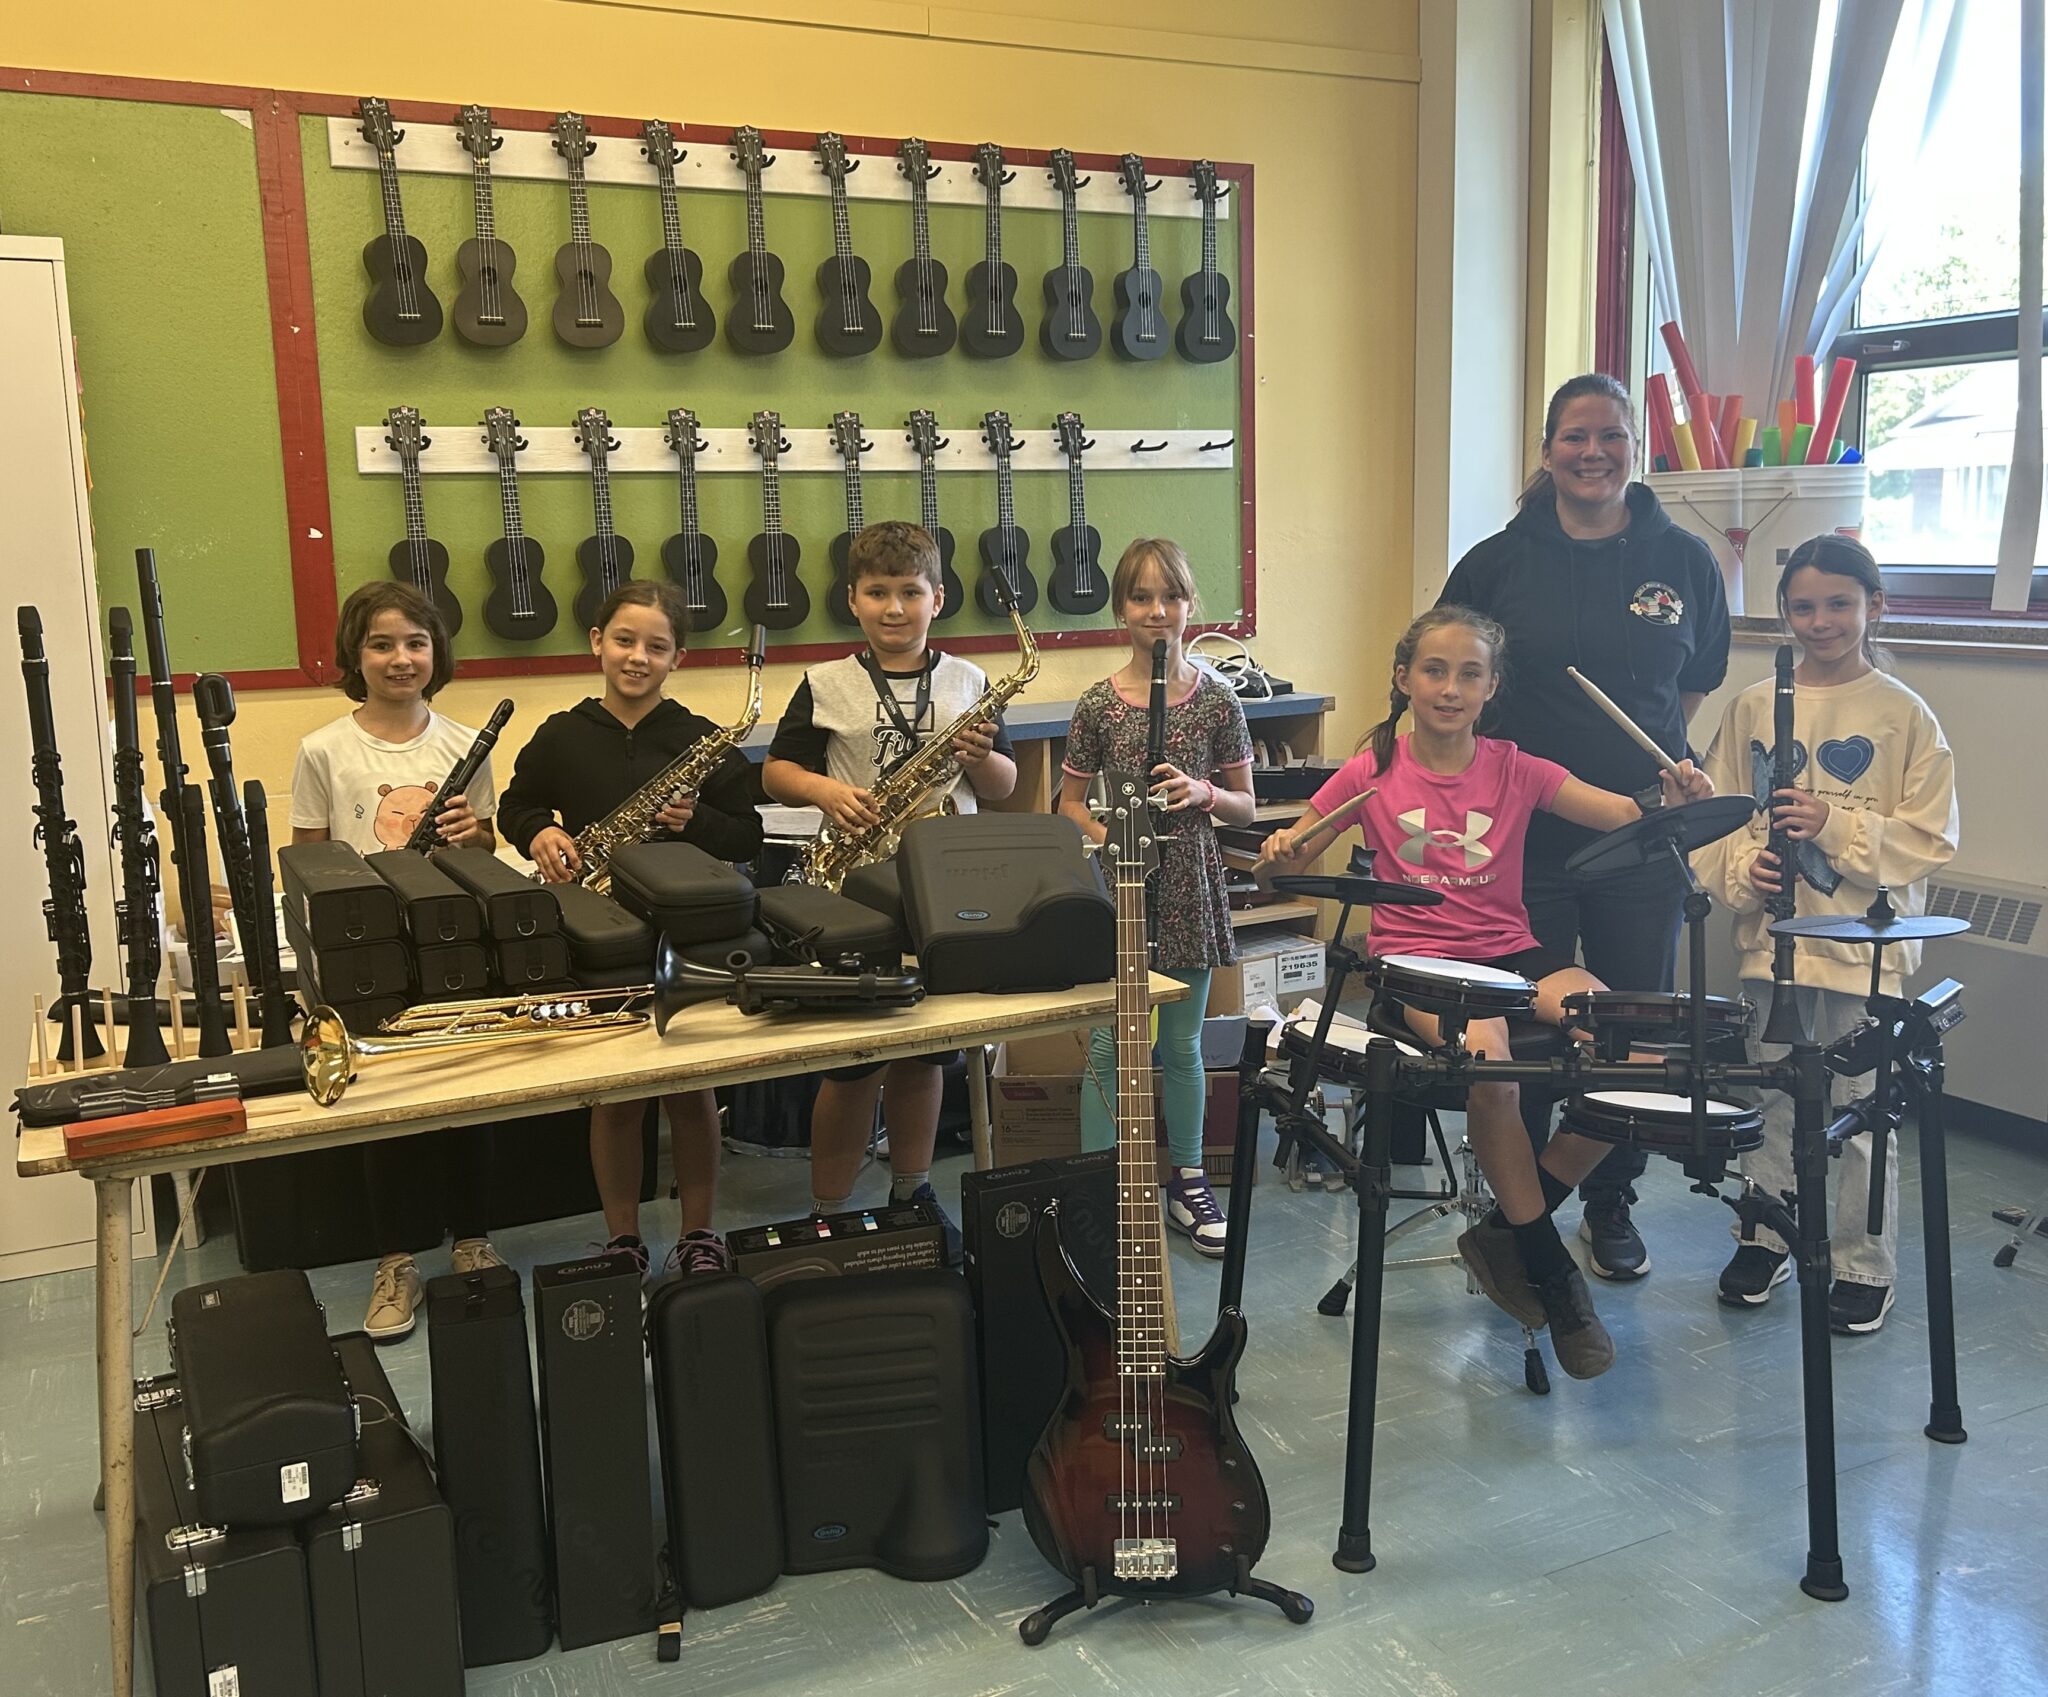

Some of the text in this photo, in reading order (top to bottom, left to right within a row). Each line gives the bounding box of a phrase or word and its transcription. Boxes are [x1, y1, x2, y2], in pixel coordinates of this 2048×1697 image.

[1402, 873, 1497, 886] NDER ARMOUR
[1281, 961, 1318, 971] 219635
